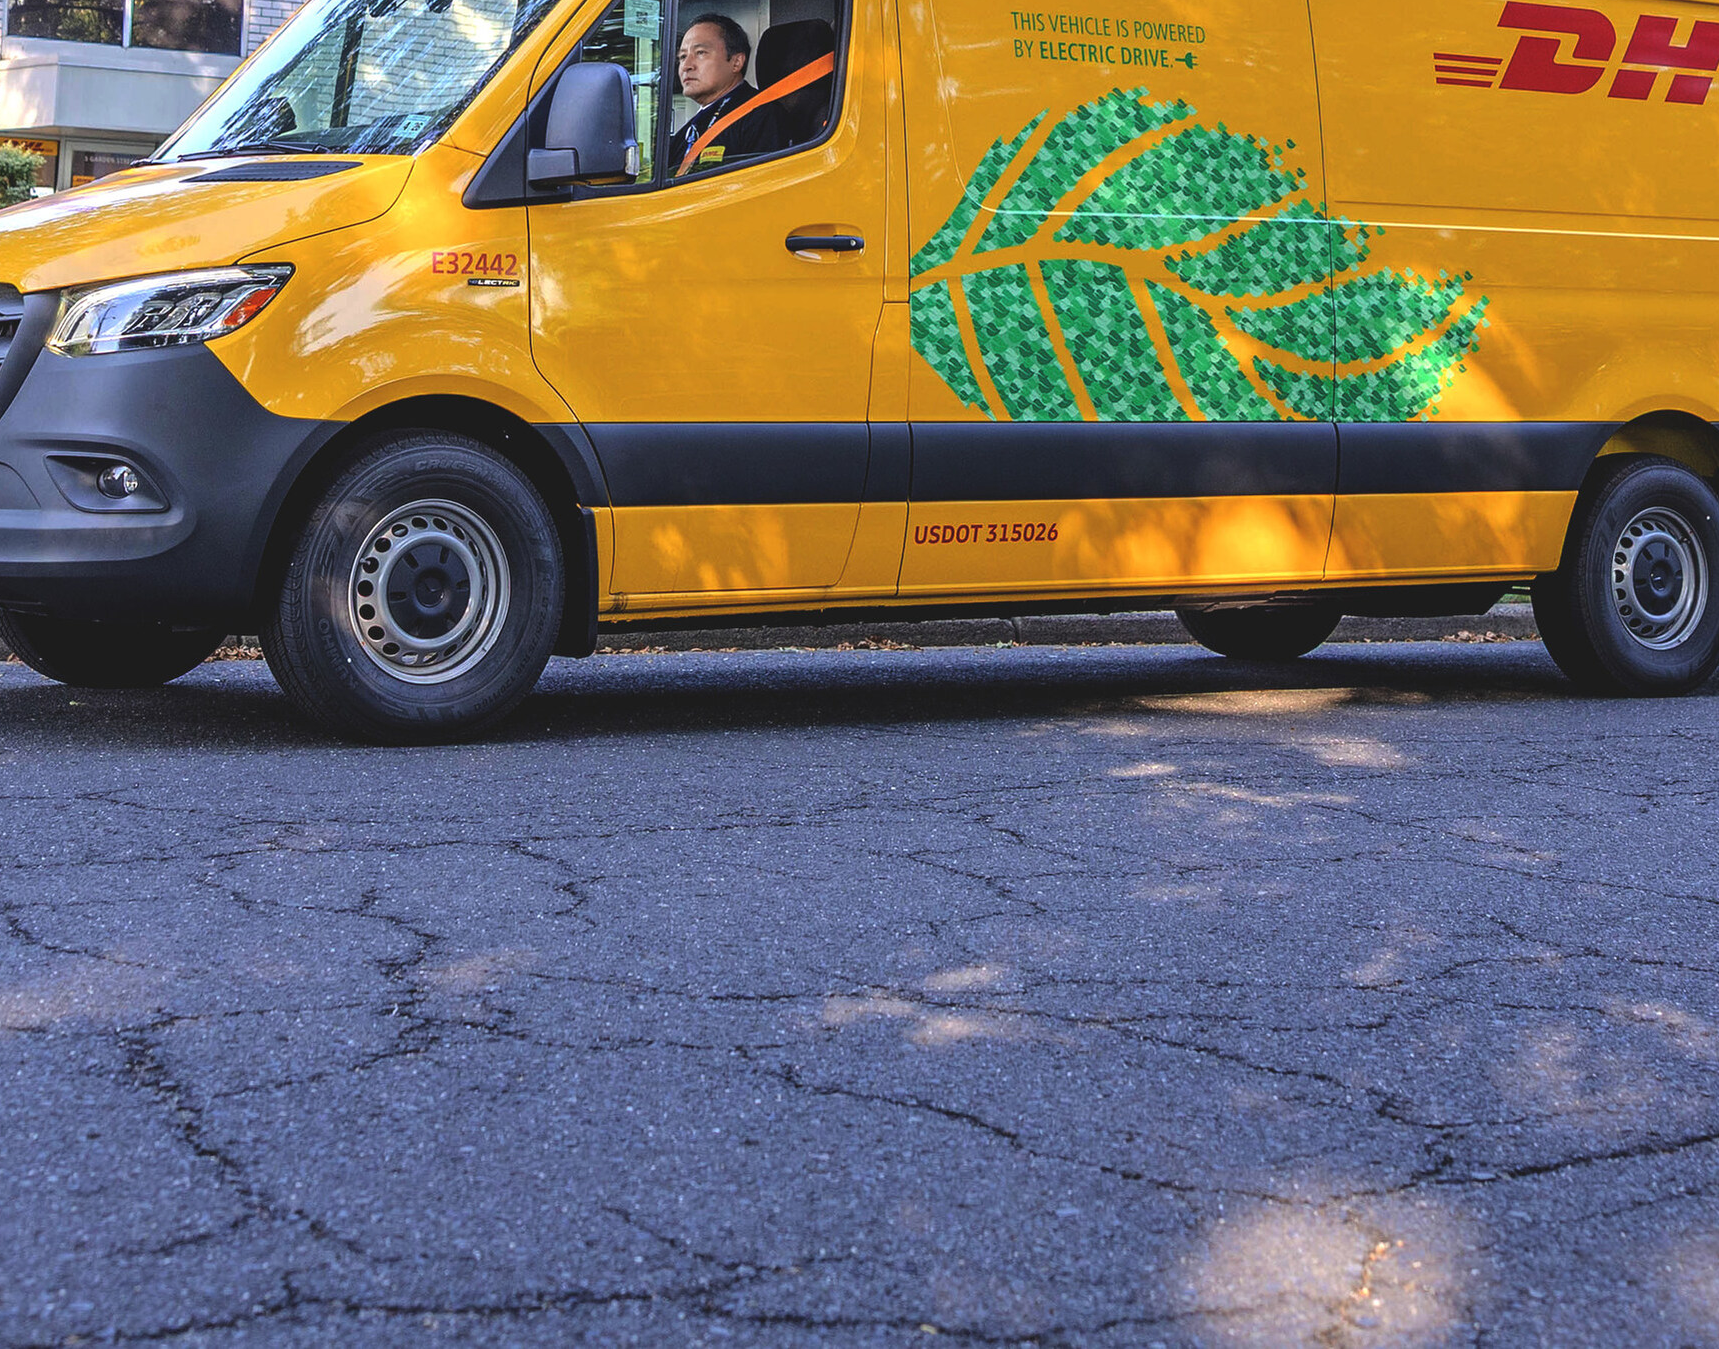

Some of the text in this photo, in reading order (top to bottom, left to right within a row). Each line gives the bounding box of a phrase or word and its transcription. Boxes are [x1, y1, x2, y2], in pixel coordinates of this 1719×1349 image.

[1010, 11, 1206, 44] THIS VEHICLE IS POWERED
[1014, 39, 1173, 68] BY ELECTRIC DRIVE.
[431, 251, 518, 276] E32442
[914, 523, 1058, 544] USDOT 315026
